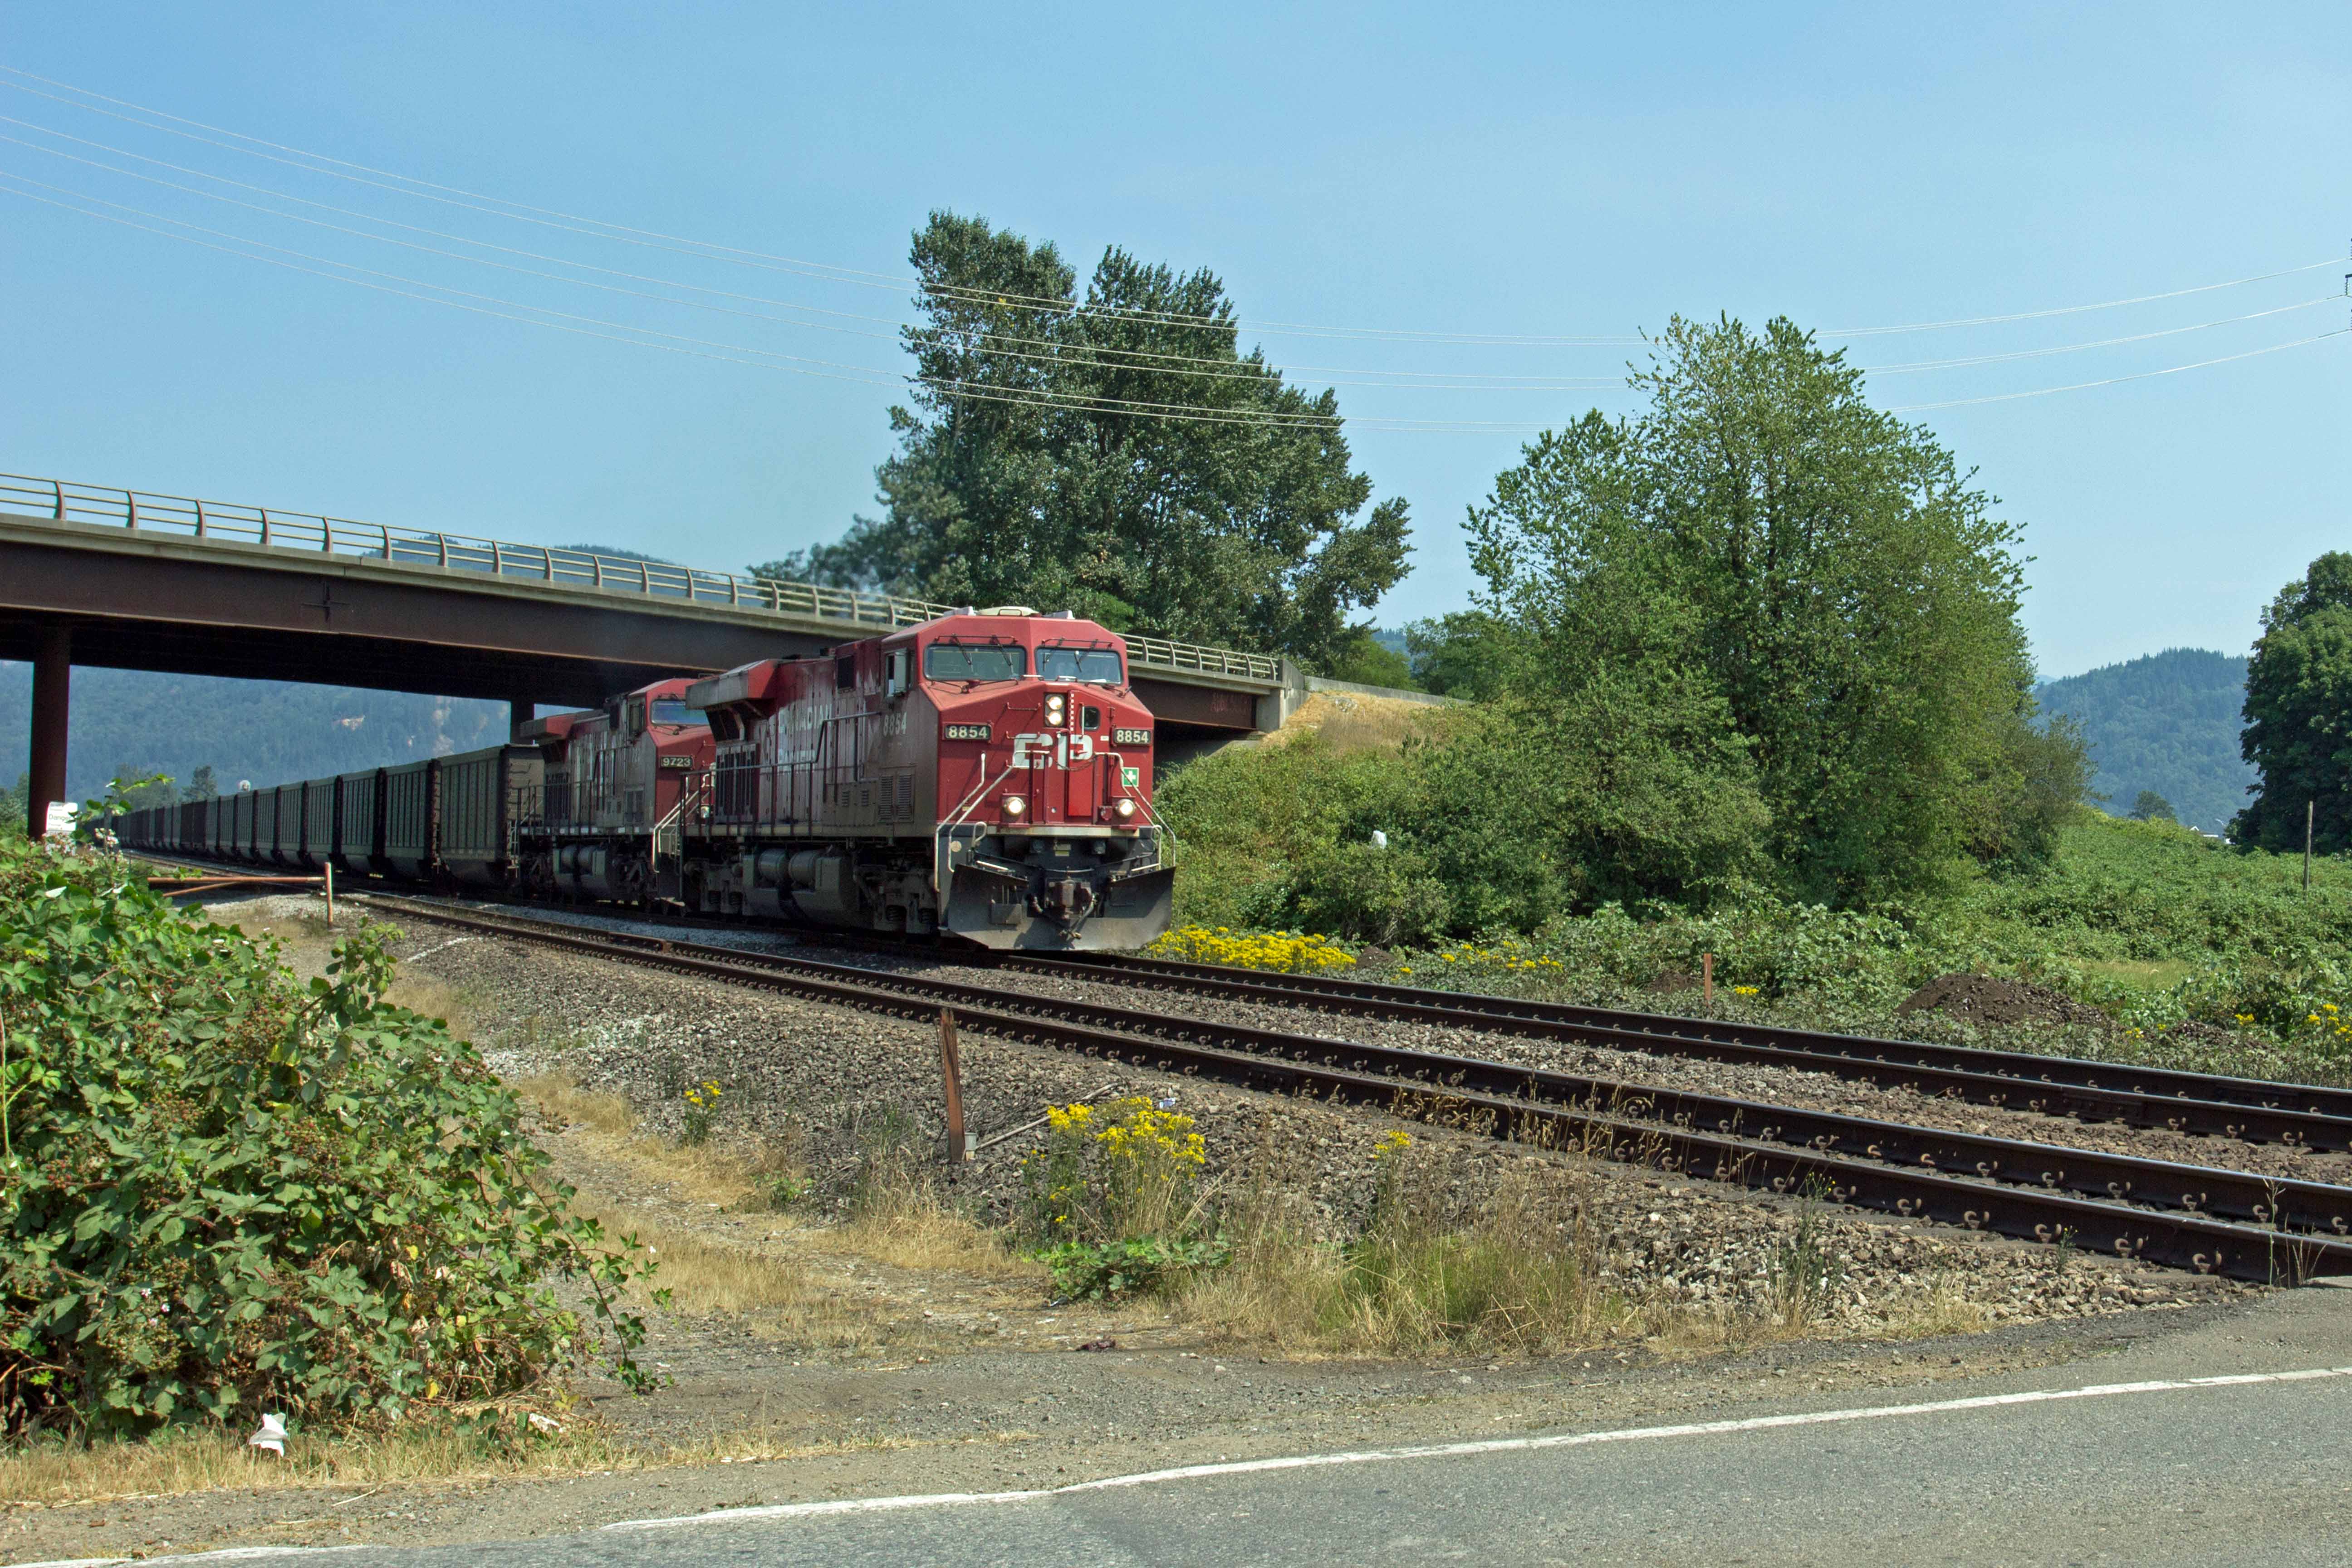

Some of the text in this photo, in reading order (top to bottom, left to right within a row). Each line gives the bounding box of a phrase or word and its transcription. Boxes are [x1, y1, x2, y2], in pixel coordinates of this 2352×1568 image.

[883, 711, 907, 737] 8854
[948, 725, 988, 738] 8854
[1117, 730, 1149, 743] 8854
[1014, 733, 1093, 770] CP
[663, 757, 691, 767] 9723
[49, 813, 72, 822] Dange
